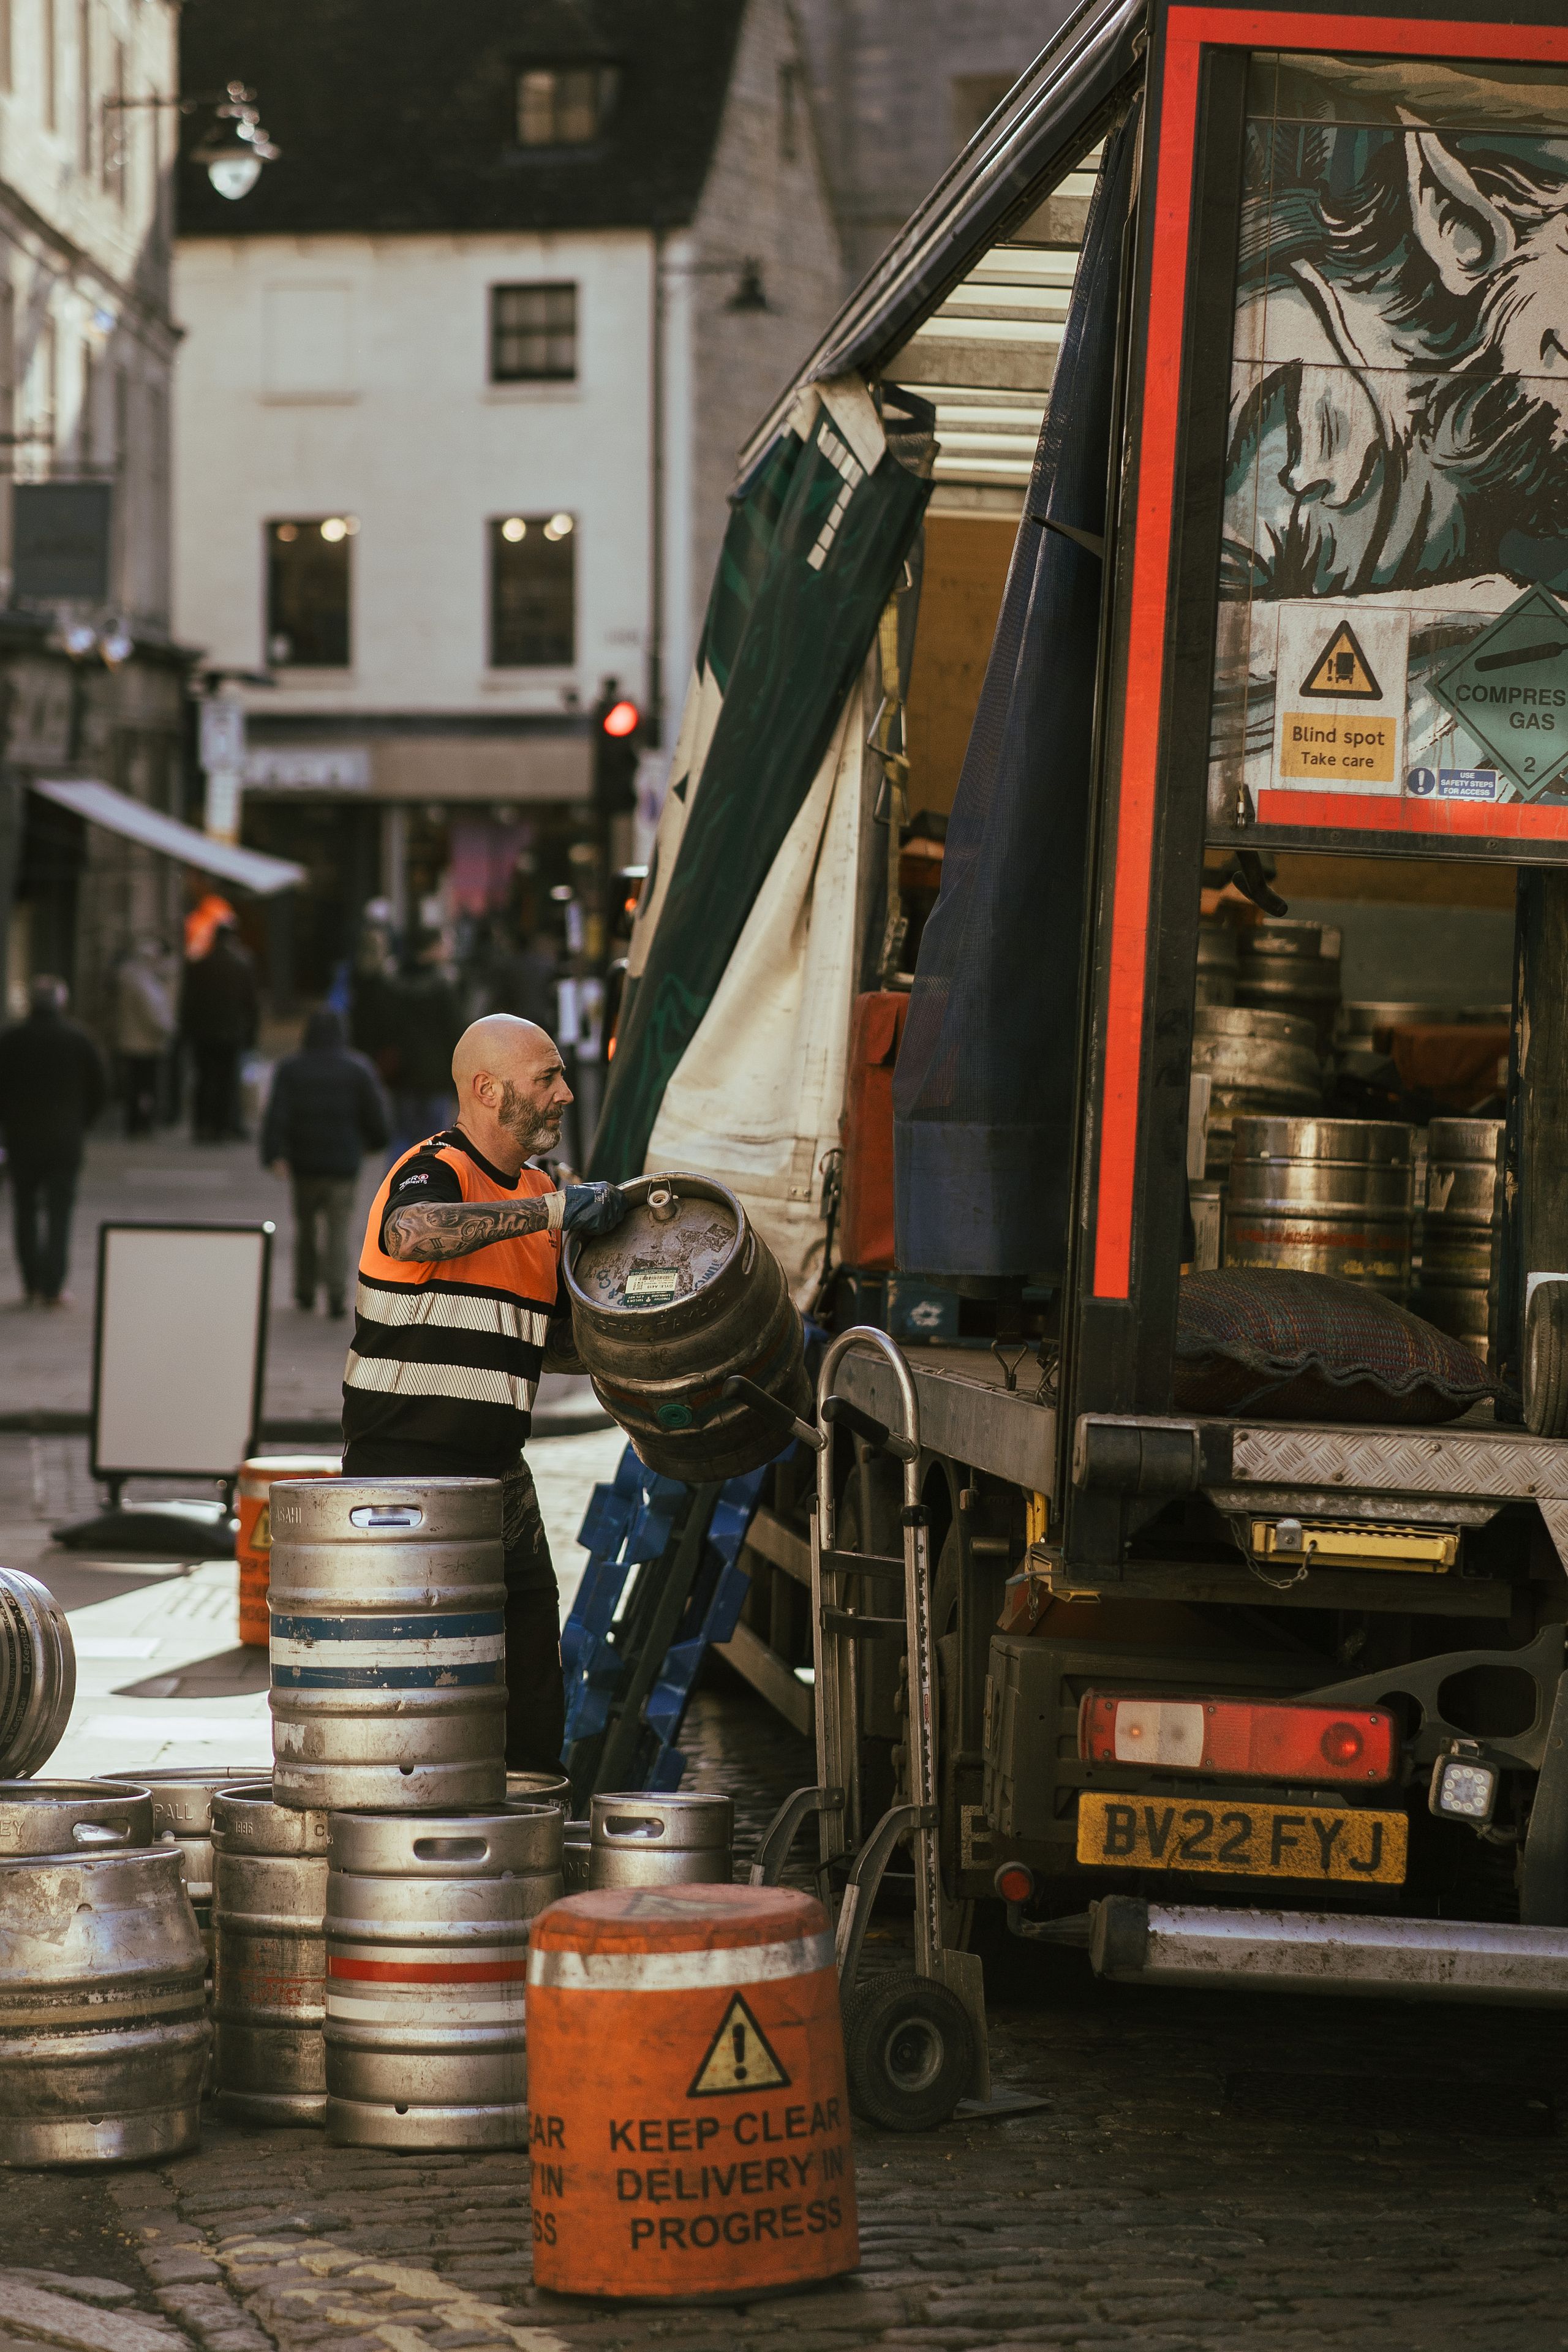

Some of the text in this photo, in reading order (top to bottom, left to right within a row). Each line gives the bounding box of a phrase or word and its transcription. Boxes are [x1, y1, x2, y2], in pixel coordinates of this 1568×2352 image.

[1455, 684, 1568, 706] COMPRES
[1509, 712, 1555, 730] GAS
[1292, 726, 1385, 748] Blind spot
[1301, 752, 1374, 767] Take care
[1524, 756, 1536, 772] 2
[461, 1218, 528, 1242] Rachel
[275, 1506, 301, 1524] ASAHI
[19, 1624, 30, 1662] Kegstar
[10, 1696, 27, 1733] Kegstar
[1103, 1804, 1383, 1872] BV22 FYJ
[610, 2097, 840, 2152] KEEP CLEAR
[617, 2144, 843, 2202] DELIVERY IN
[630, 2196, 842, 2250] PROGRESS
